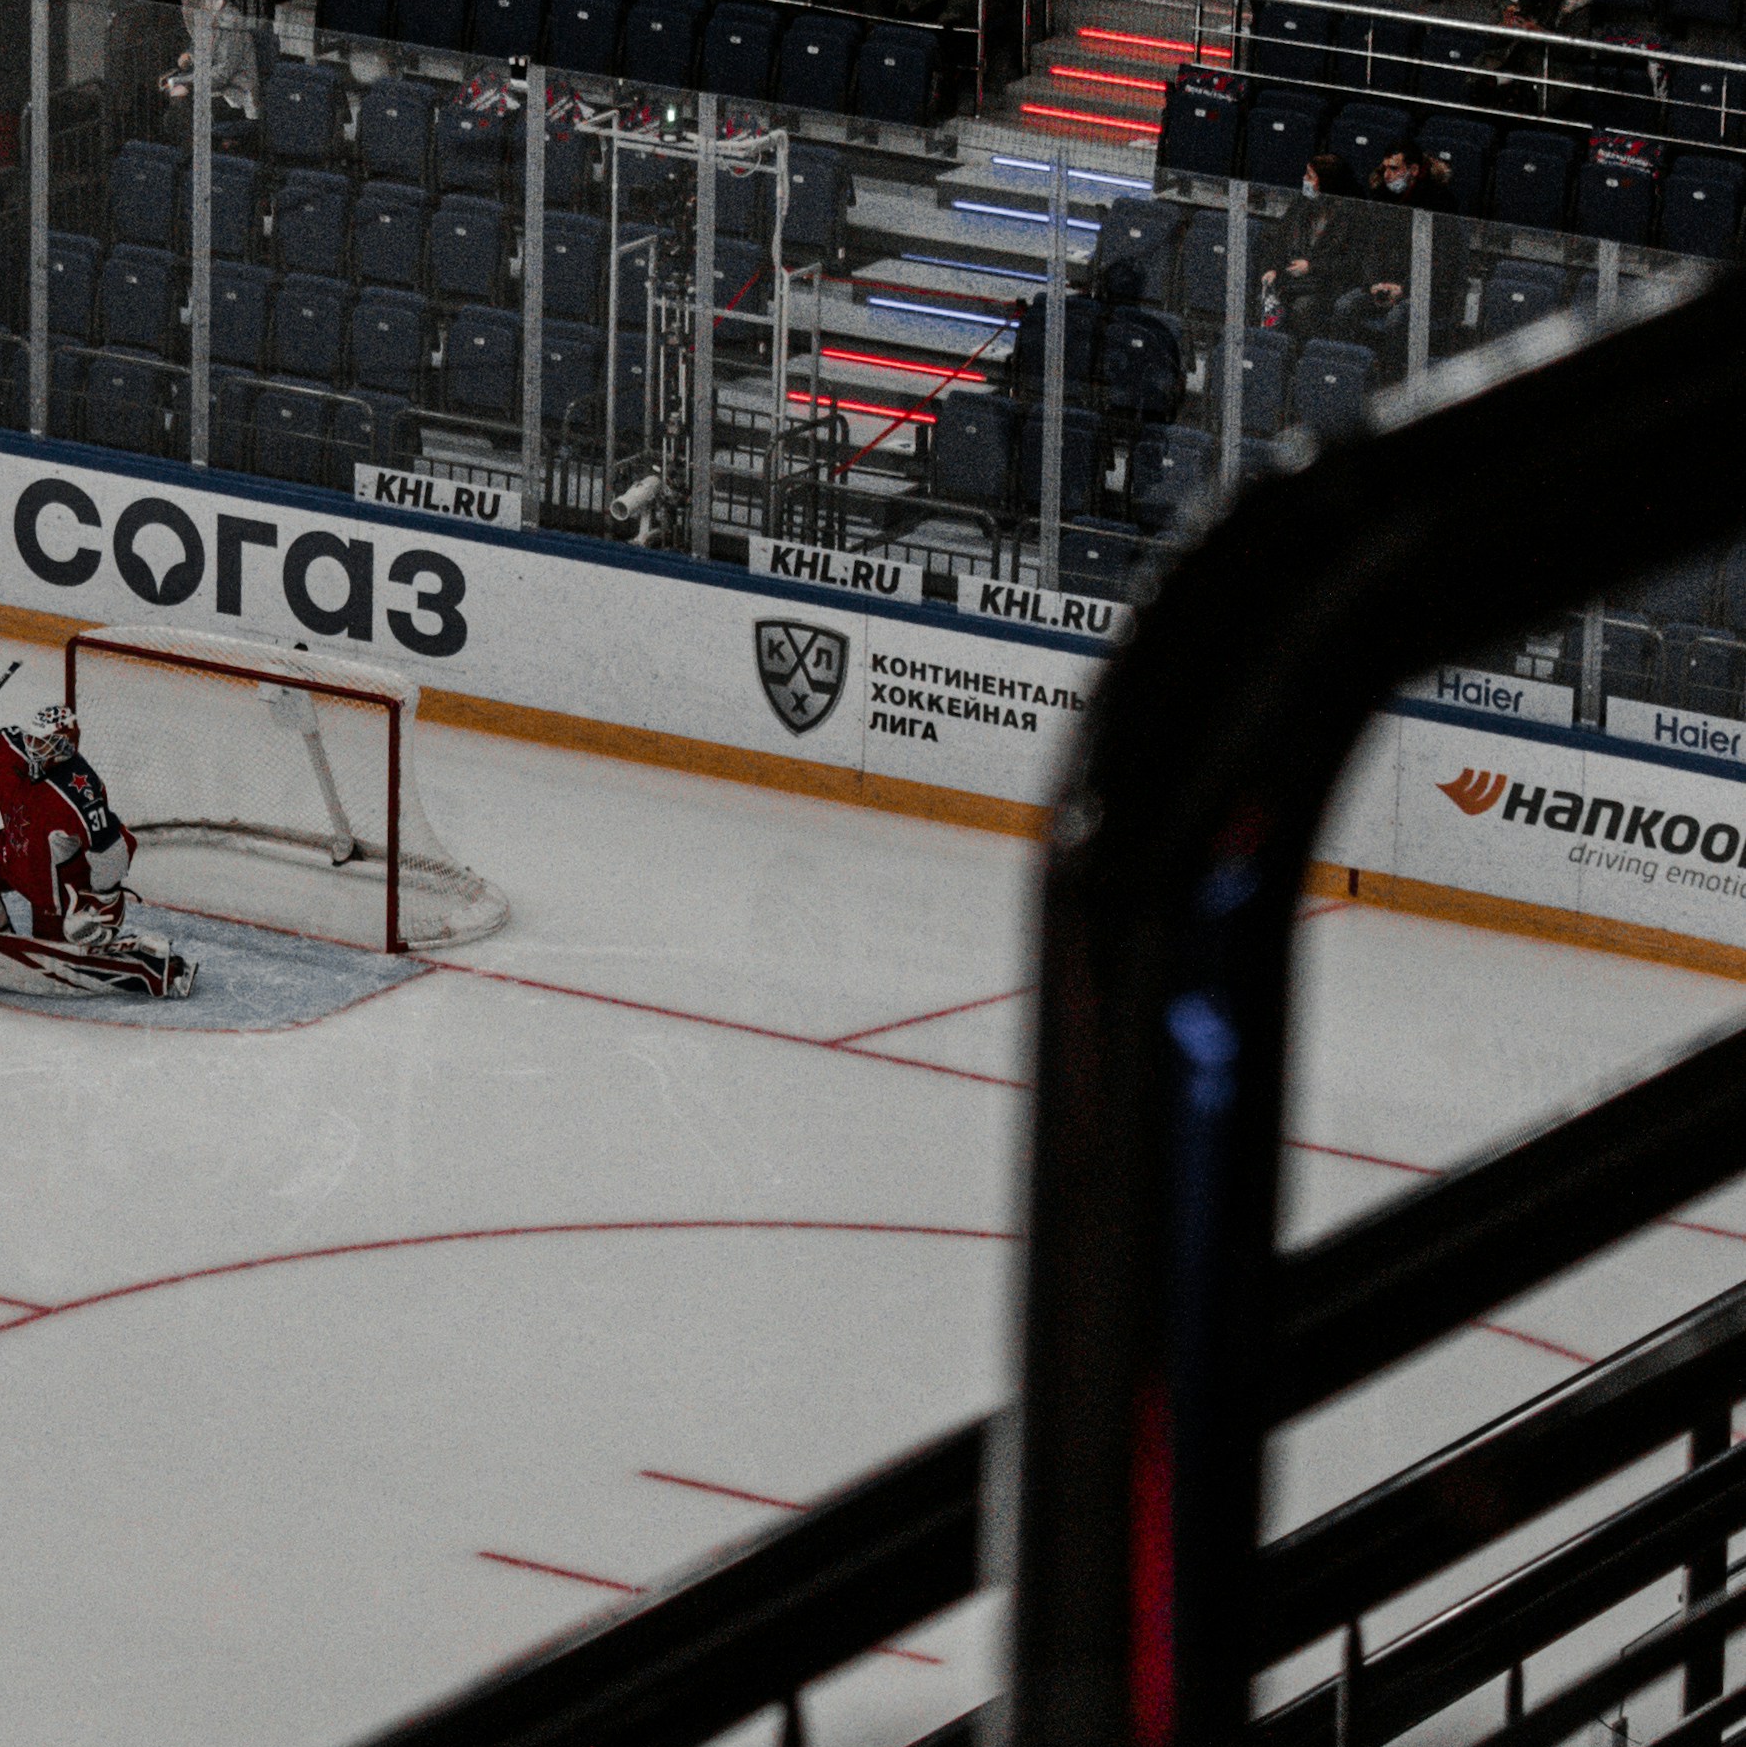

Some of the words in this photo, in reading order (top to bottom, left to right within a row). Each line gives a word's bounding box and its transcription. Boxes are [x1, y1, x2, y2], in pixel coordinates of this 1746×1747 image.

[374, 472, 501, 521] KHL.RU
[770, 544, 901, 595] KHL.RU
[979, 583, 1113, 635] KHL.RU
[871, 682, 1038, 733] ХОККЕЙНАЯ
[1437, 668, 1524, 712] Haier
[869, 711, 938, 742] ЛИГА
[1655, 713, 1741, 755] Haier
[87, 805, 109, 832] 31
[1502, 782, 1746, 870] Hankoo
[1567, 842, 1660, 883] driving
